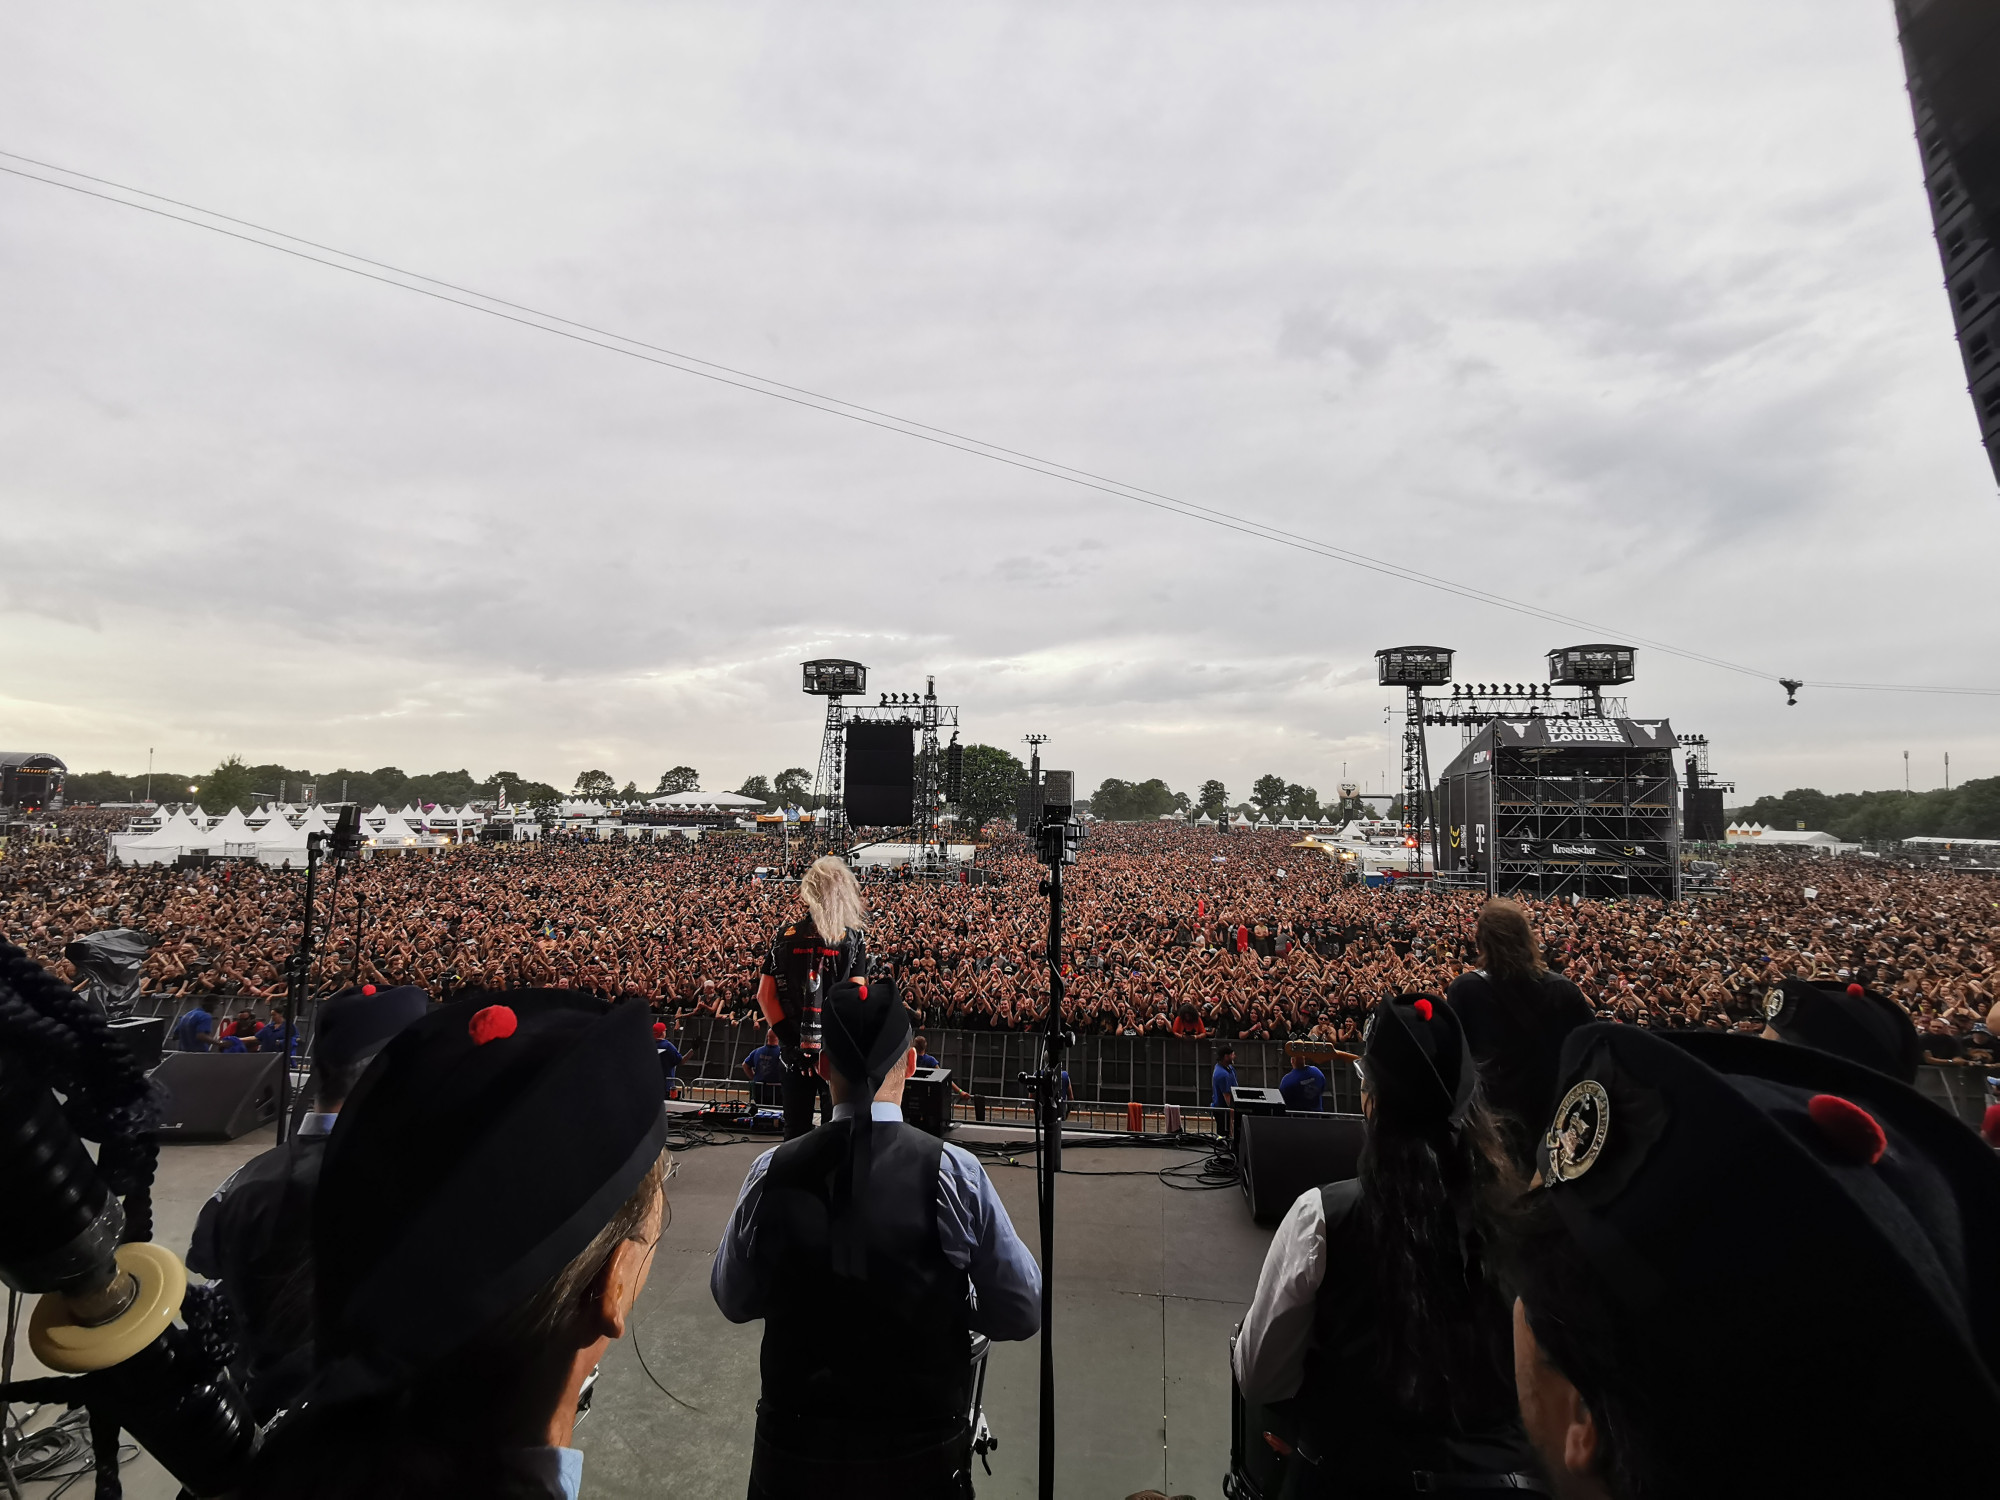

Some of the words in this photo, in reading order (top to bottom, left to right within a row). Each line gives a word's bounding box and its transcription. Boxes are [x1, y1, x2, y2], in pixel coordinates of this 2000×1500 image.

[1544, 718, 1618, 728] FASTER
[1546, 725, 1622, 735] HARDER
[1548, 733, 1626, 743] LOUDER
